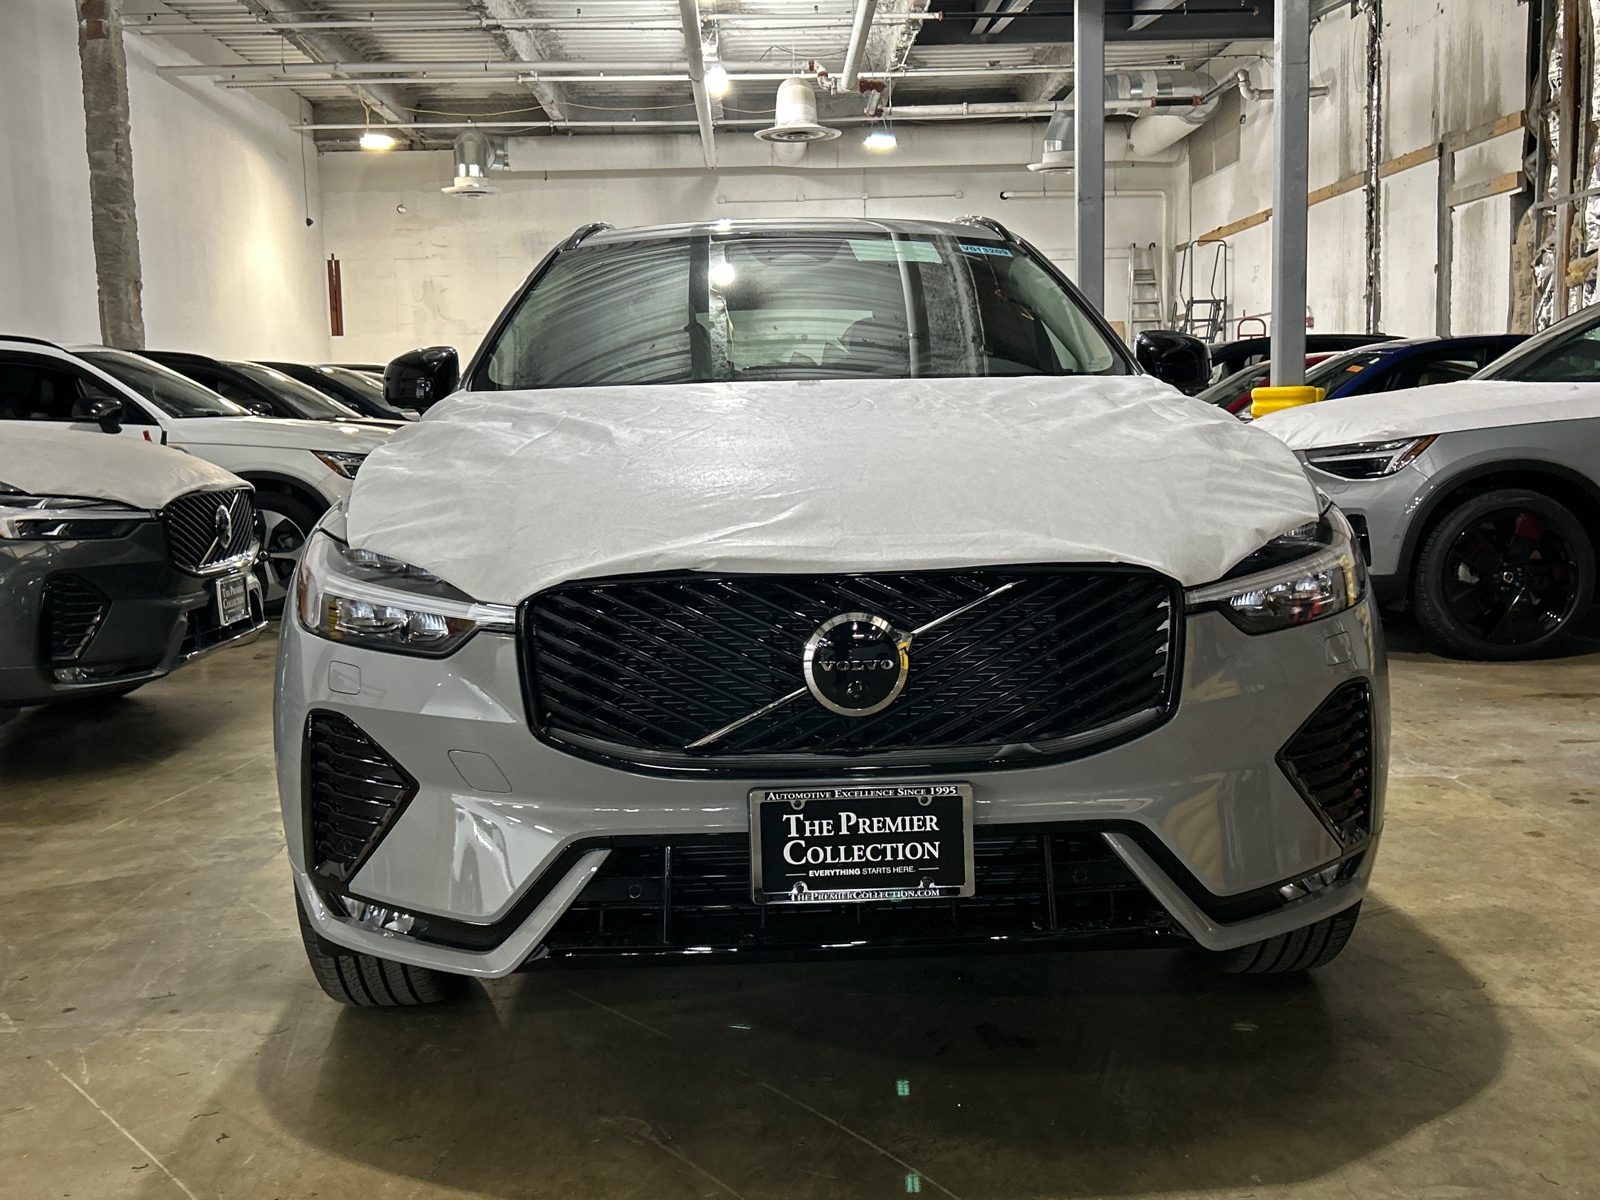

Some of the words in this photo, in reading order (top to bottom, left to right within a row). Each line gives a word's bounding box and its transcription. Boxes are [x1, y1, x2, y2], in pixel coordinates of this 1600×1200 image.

[818, 659, 894, 672] VOLVO
[767, 791, 832, 801] AUTOMOTIVE
[834, 789, 895, 798] EXCELLENCE
[897, 787, 926, 797] SINCE
[929, 786, 957, 796] 1995
[782, 813, 835, 838] THE
[838, 811, 940, 835] PREMIER
[783, 839, 941, 866] COLLECTION
[808, 868, 861, 877] EVERYTHING
[862, 866, 892, 875] STARTS
